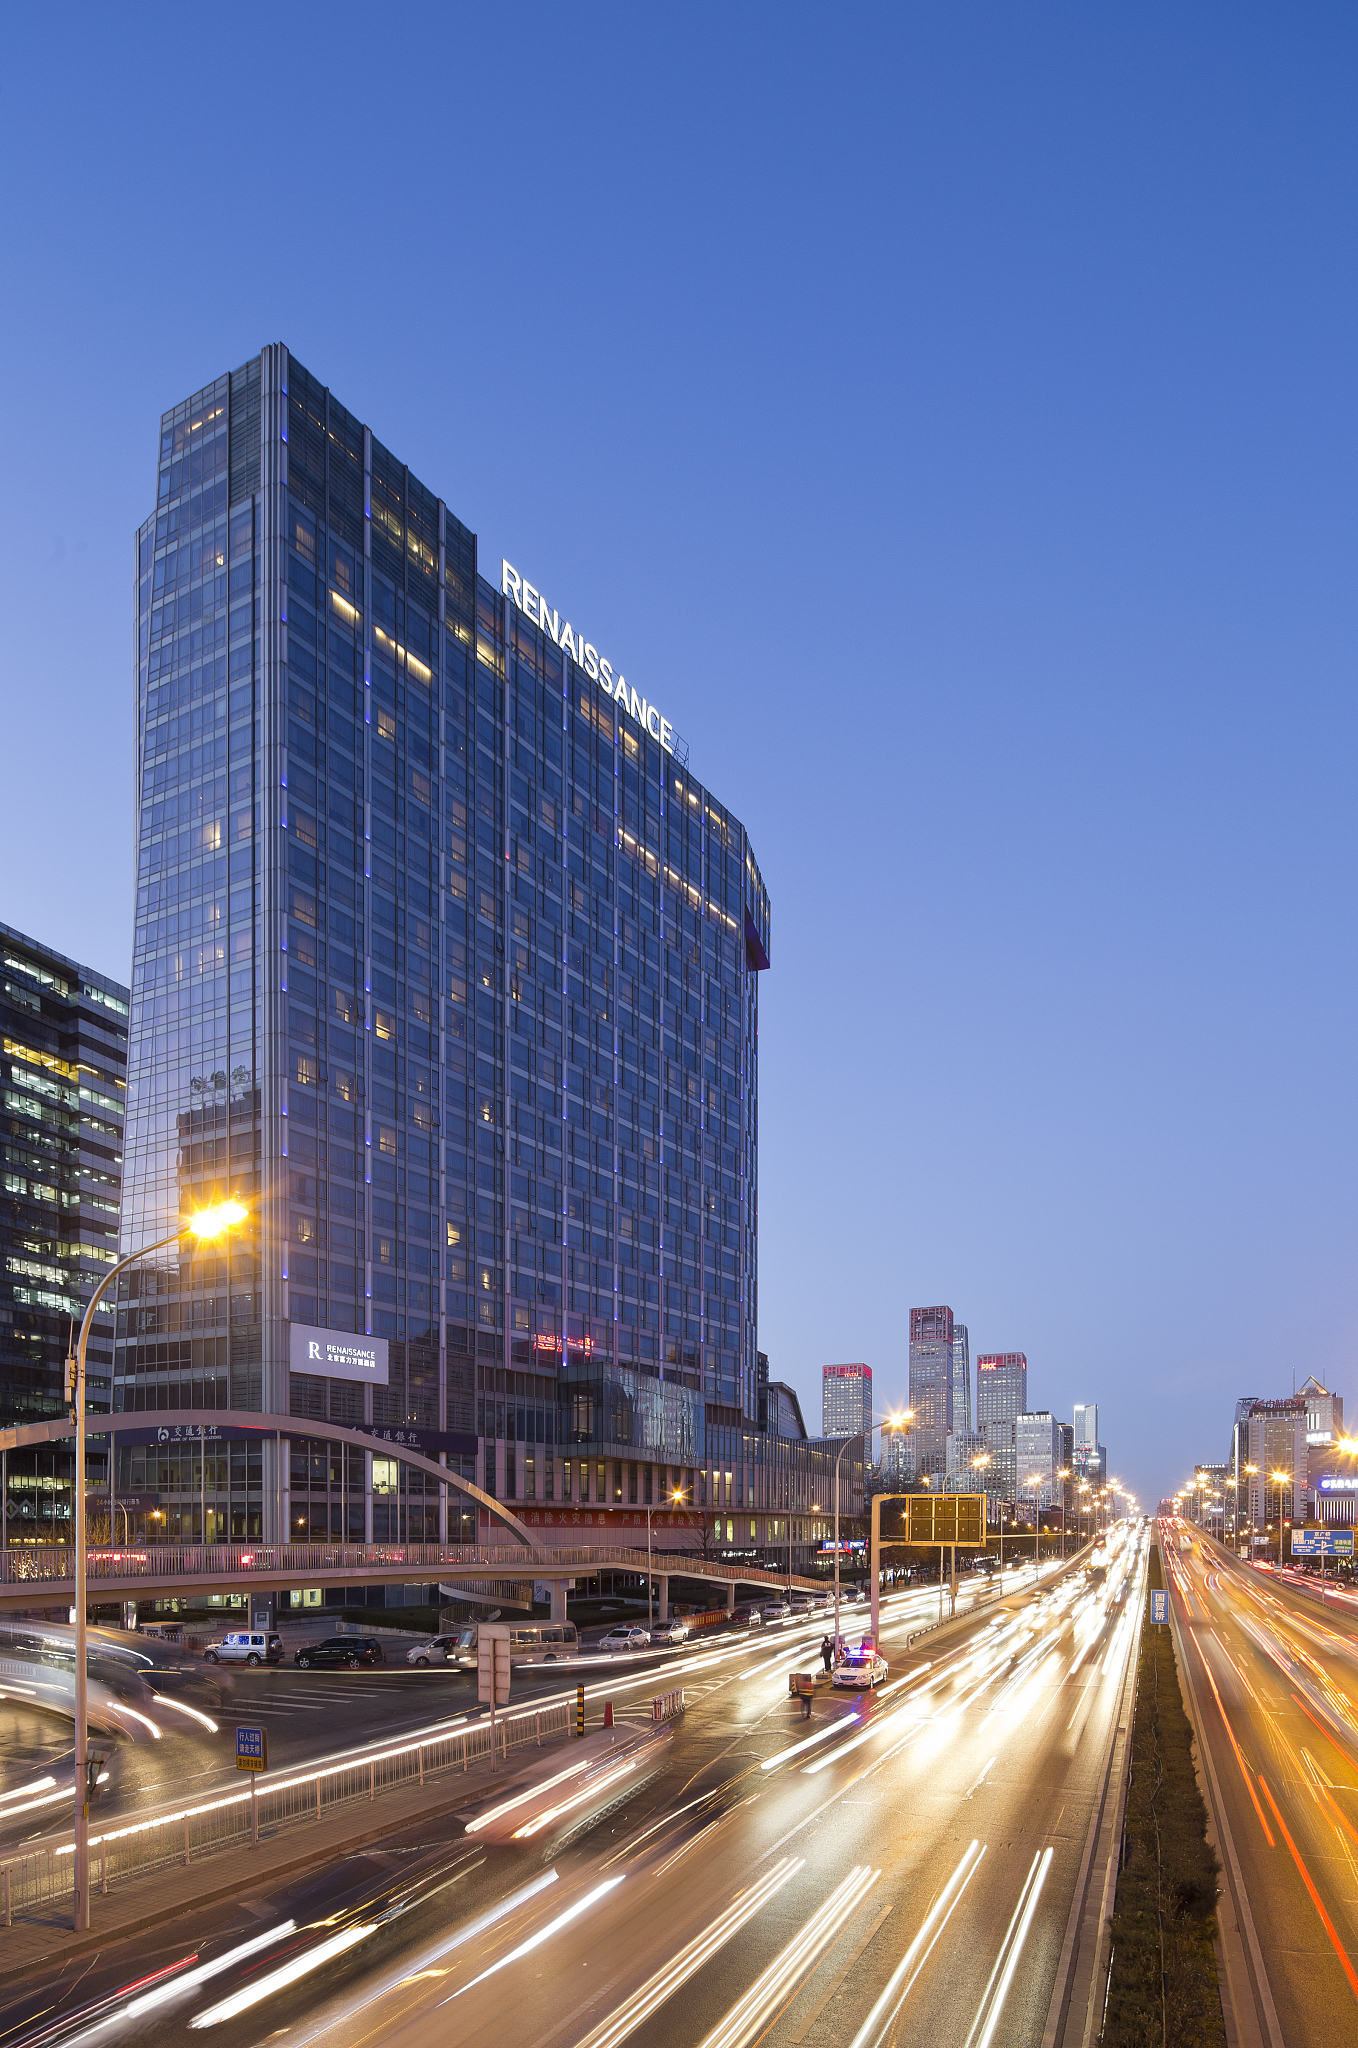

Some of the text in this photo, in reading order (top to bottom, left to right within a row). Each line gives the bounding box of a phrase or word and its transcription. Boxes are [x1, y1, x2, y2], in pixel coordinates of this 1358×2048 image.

[502, 558, 673, 754] RENAISSANCE
[308, 1341, 323, 1360] R
[326, 1345, 375, 1360] RENAISSANCE
[1155, 1593, 1165, 1621] 国贸桥
[239, 1732, 260, 1743] 行人过街
[239, 1743, 260, 1755] 请走天桥
